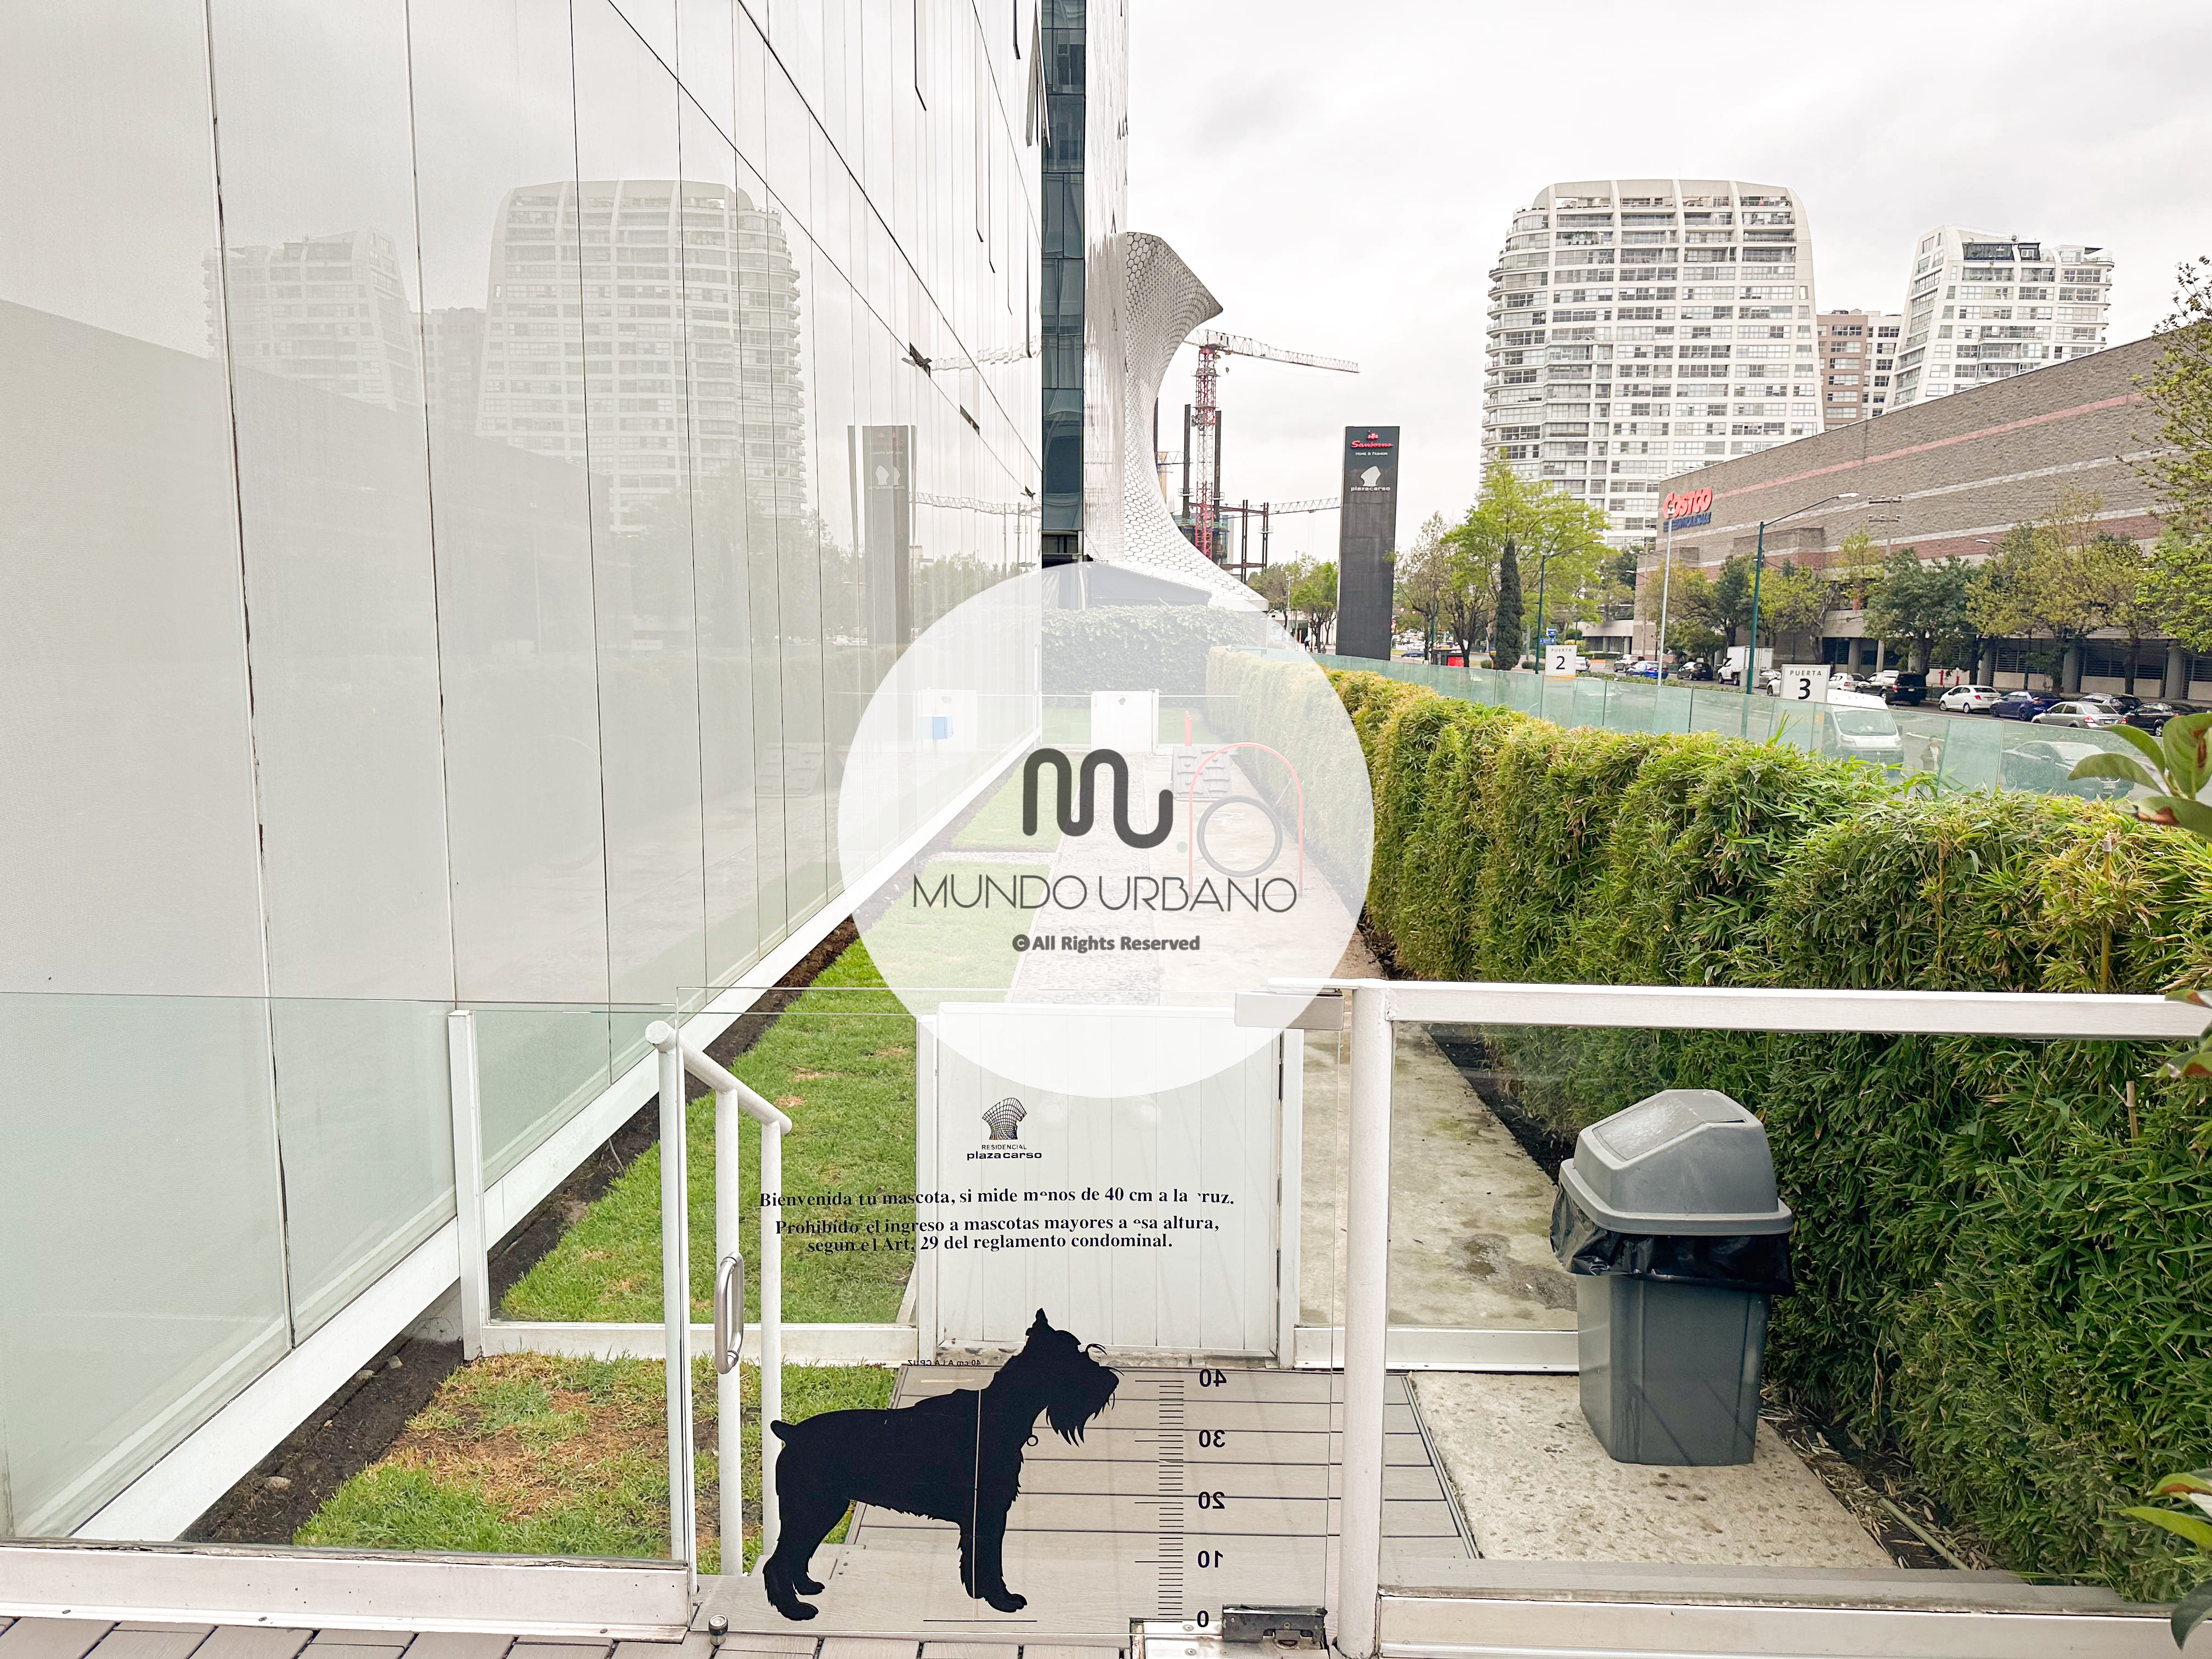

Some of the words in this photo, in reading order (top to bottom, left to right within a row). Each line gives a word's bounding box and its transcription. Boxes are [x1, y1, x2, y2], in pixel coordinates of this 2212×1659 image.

[1663, 487, 1712, 520] COSTCO
[1556, 656, 1565, 670] 2
[1798, 678, 1811, 700] 3
[760, 1191, 853, 1207] Bienvenida
[859, 1193, 877, 1206] tu
[883, 1190, 955, 1205] mascota,
[960, 1188, 972, 1203] si
[978, 1188, 1018, 1202] mide
[1081, 1187, 1099, 1201] de
[1105, 1187, 1124, 1201] 40
[1129, 1191, 1153, 1201] cm
[1159, 1192, 1168, 1202] a
[1173, 1188, 1188, 1202] la
[1197, 1192, 1234, 1205] ruz.
[866, 1220, 880, 1234] el
[885, 1218, 944, 1236] ingreso
[950, 1221, 959, 1231] a
[964, 1217, 1039, 1231] mascotas
[1044, 1219, 1113, 1232] mayores
[1119, 1219, 1127, 1229] a
[1163, 1215, 1219, 1232] altura,
[808, 1242, 855, 1255] segun
[881, 1237, 915, 1251] Art.
[920, 1235, 939, 1250] 29
[944, 1235, 968, 1249] del
[974, 1234, 1066, 1252] reglamento
[1071, 1233, 1172, 1247] condominal.
